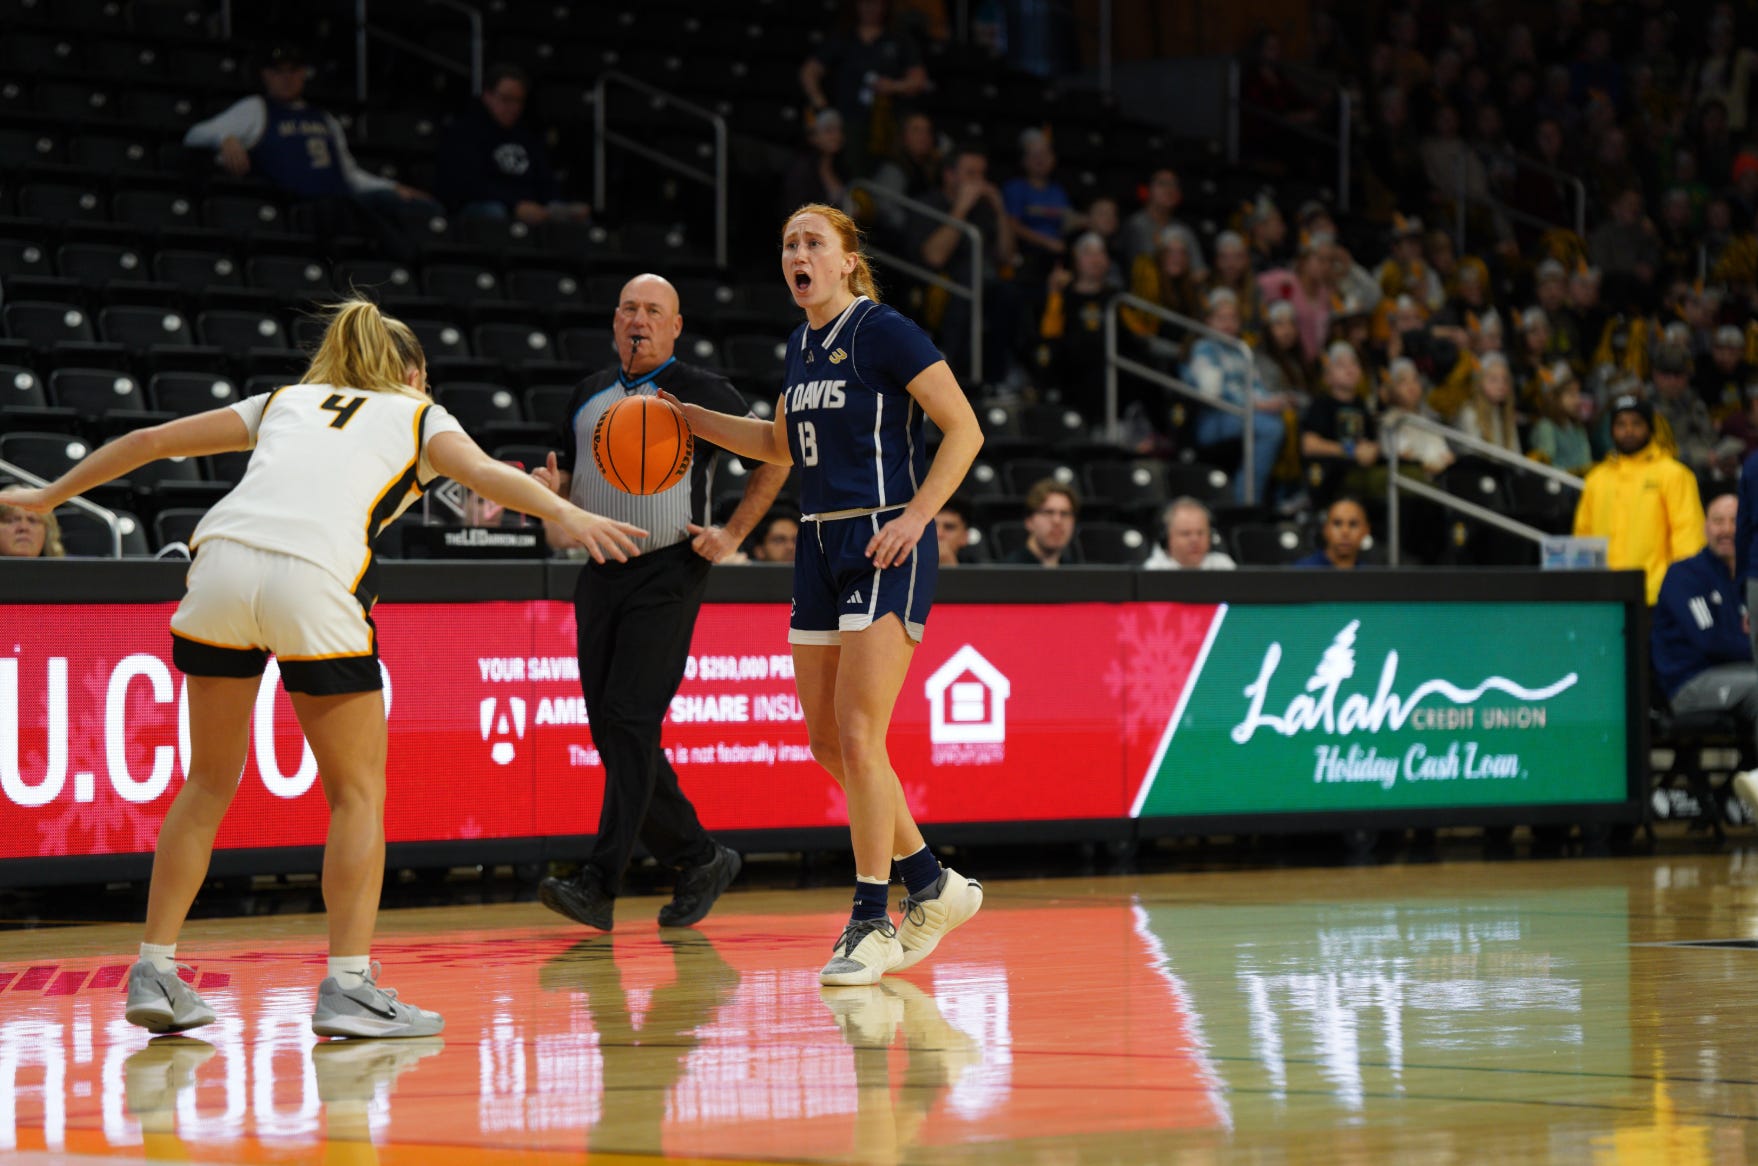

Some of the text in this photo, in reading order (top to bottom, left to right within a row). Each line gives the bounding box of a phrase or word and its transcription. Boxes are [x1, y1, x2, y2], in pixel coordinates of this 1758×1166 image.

[320, 393, 369, 430] 4
[792, 380, 847, 413] DAVIS
[797, 421, 819, 467] 13
[478, 657, 525, 681] YOUR
[528, 656, 581, 681] SAVIN
[670, 694, 750, 722] SHARE
[754, 693, 805, 722] INSU
[1411, 706, 1547, 730] CREDIT UNION
[568, 744, 602, 766] This
[676, 742, 688, 764] is
[691, 745, 715, 763] not
[1313, 742, 1400, 790] Holiday
[1403, 740, 1459, 782] Cash
